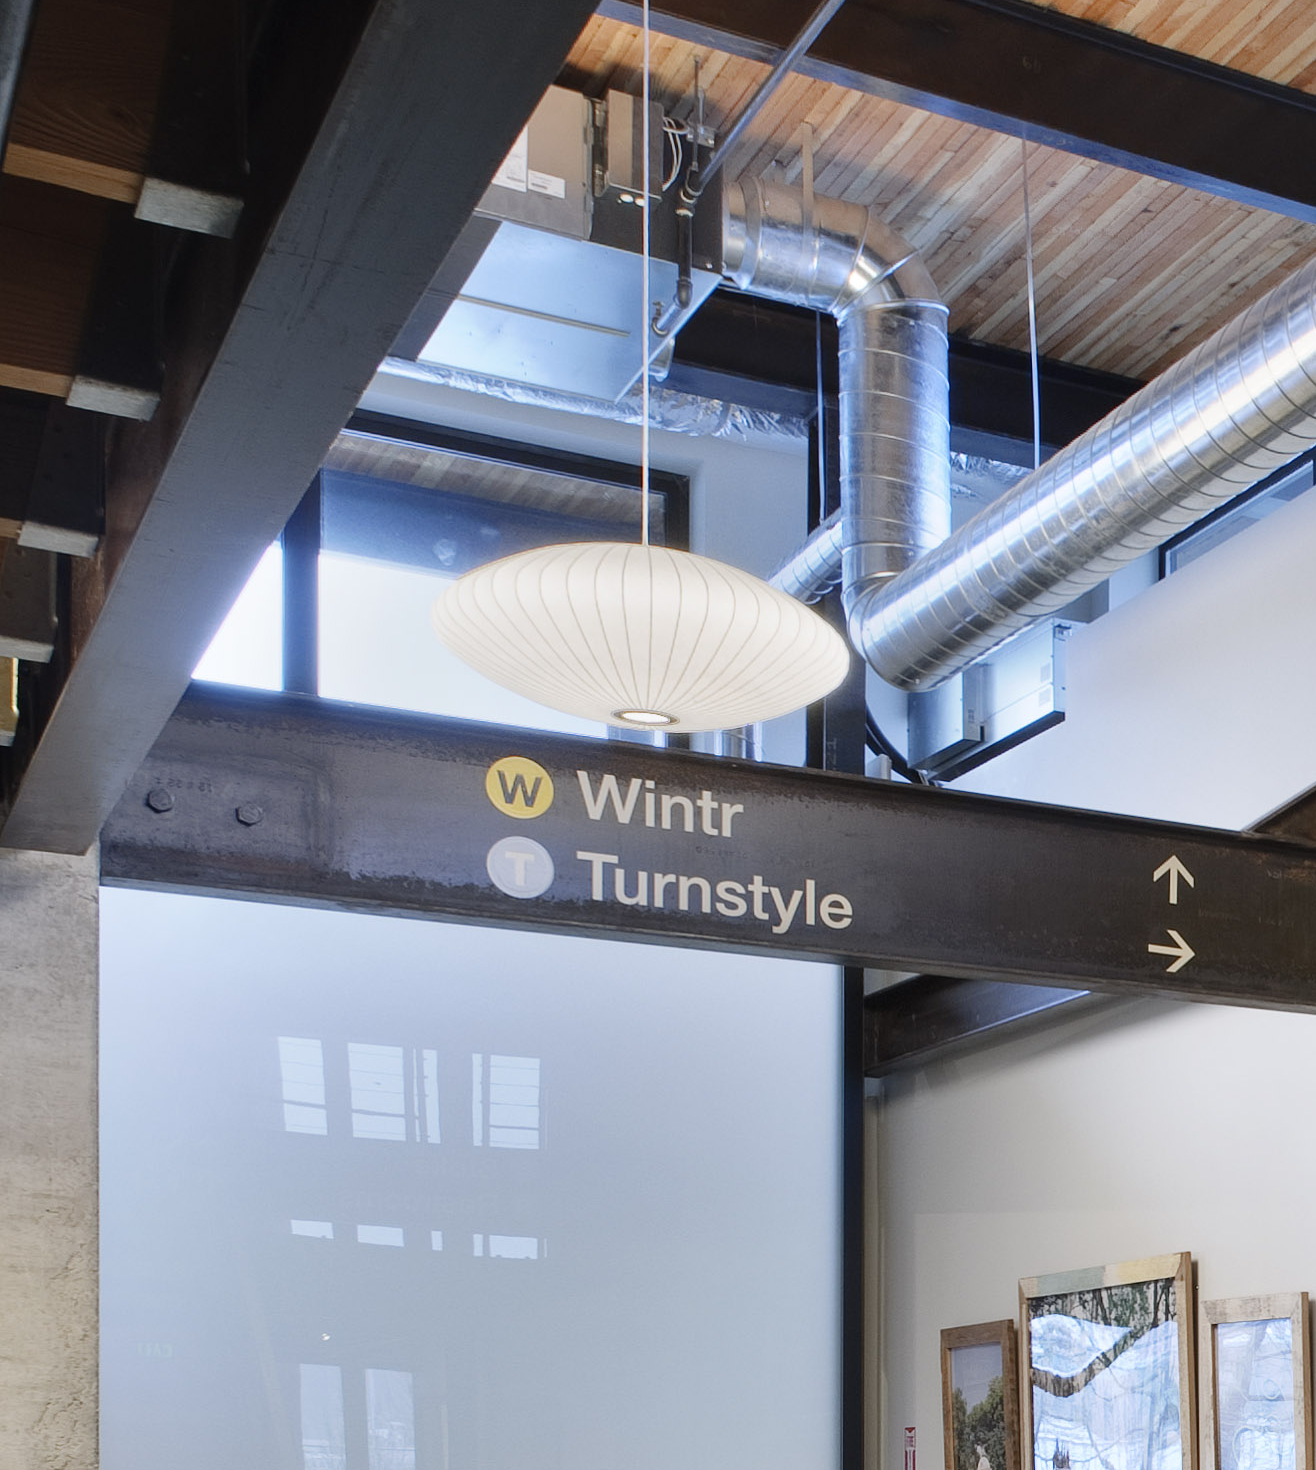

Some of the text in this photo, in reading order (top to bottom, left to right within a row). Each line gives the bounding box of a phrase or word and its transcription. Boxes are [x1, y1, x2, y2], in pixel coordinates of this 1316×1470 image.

[495, 769, 744, 837] W Wintr
[503, 850, 853, 933] T Turnstyle
